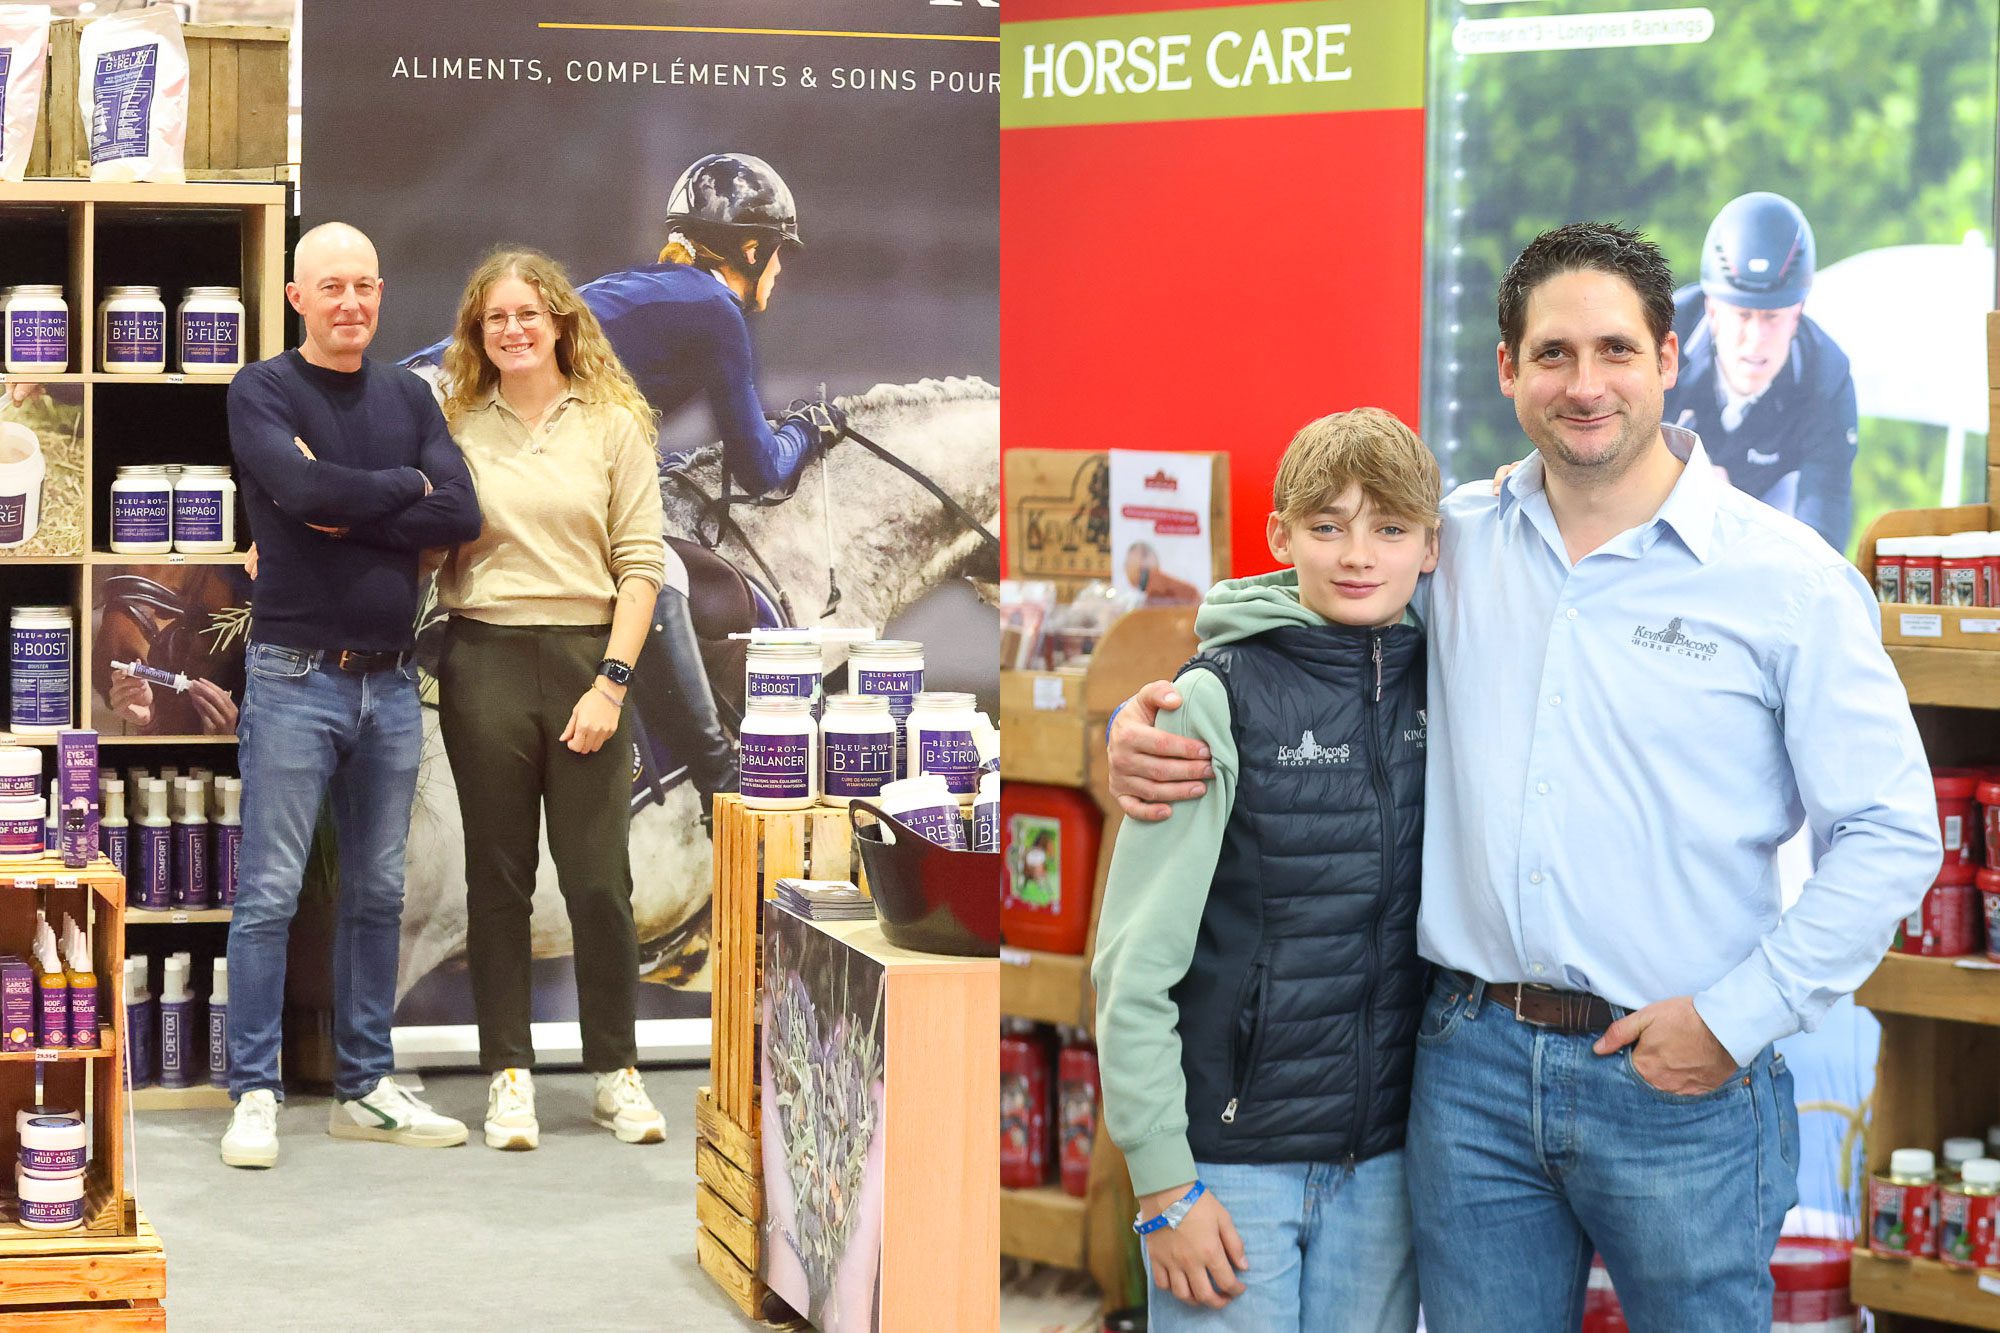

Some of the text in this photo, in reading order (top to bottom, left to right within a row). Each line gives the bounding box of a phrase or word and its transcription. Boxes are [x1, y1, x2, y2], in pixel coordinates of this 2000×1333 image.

[1022, 23, 1352, 99] HORSE CARE
[392, 56, 1000, 94] ALIMENTS, COMPLÉMENTS & SOINS POUR
[1404, 728, 1426, 742] KING
[745, 744, 766, 752] BLEU
[926, 750, 980, 763] B·STRON
[908, 815, 935, 826] BLEU
